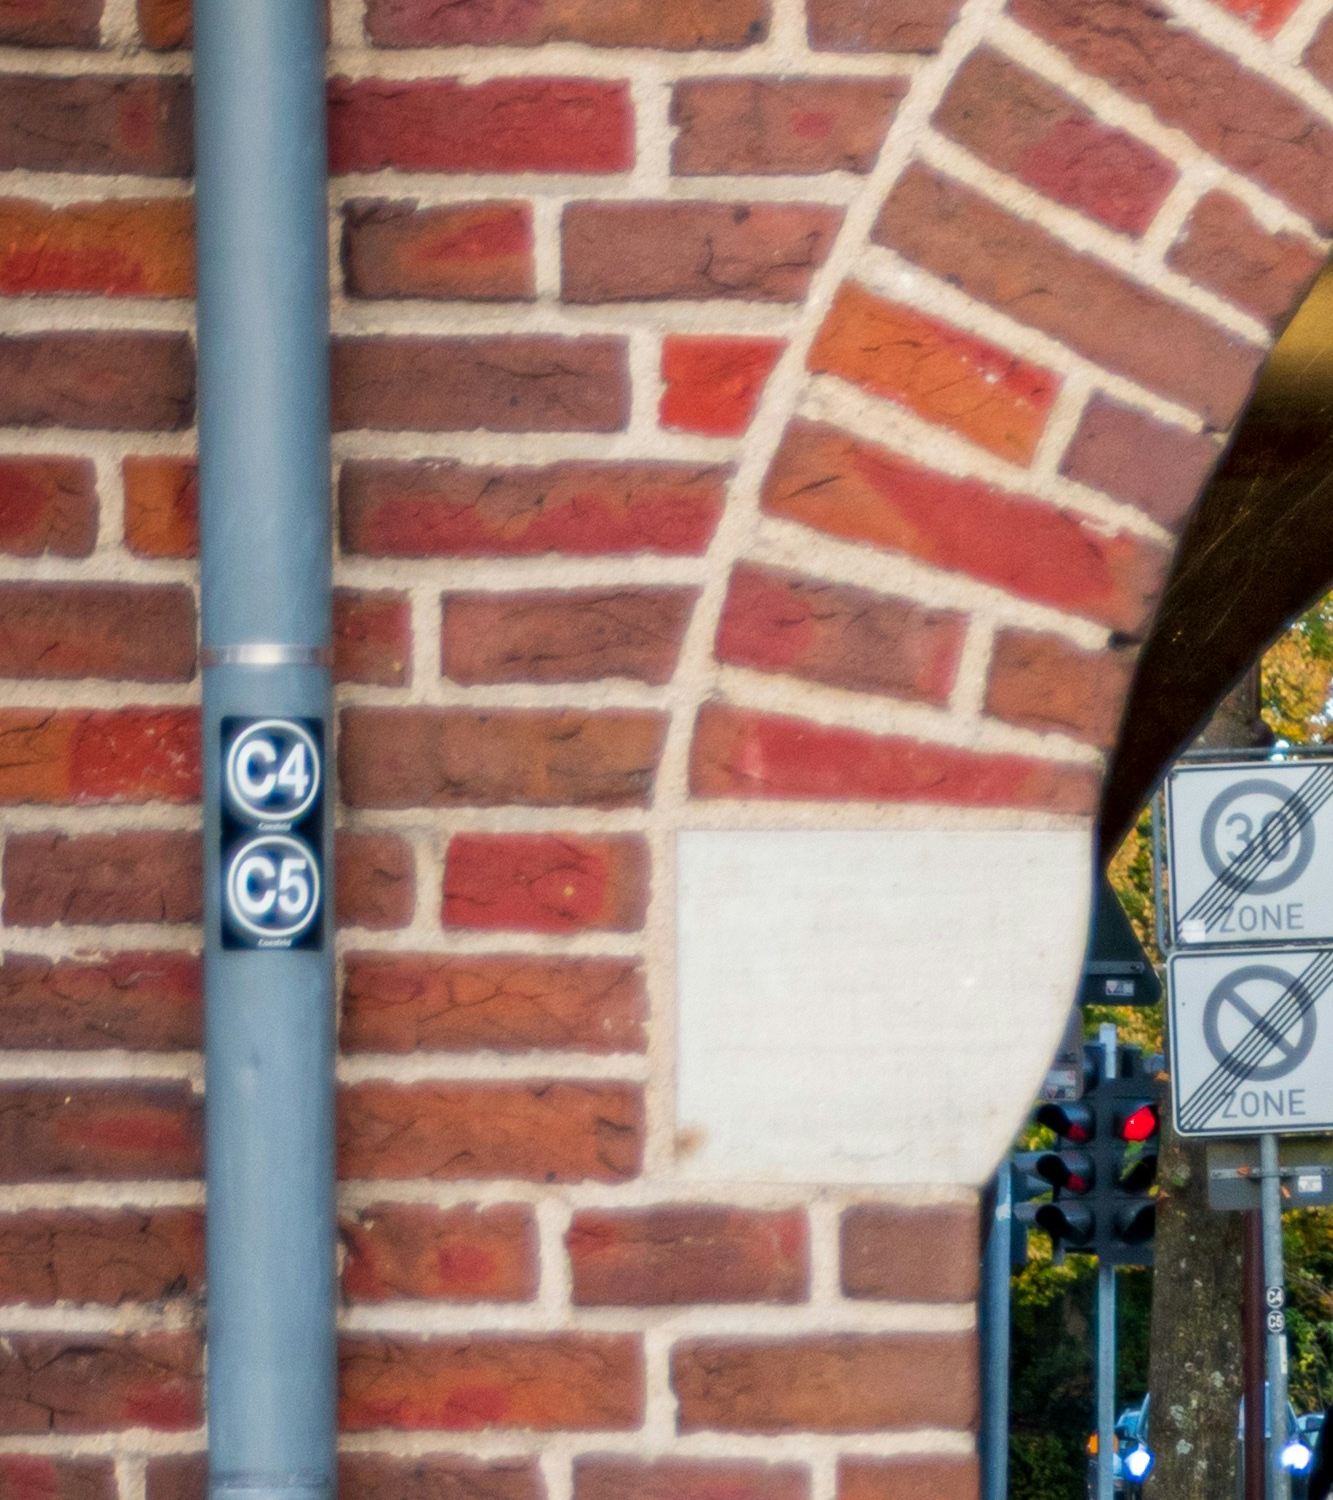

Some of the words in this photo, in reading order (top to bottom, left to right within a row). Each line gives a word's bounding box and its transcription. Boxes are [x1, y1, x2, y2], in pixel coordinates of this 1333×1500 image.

[236, 739, 310, 800] C4
[1224, 810, 1291, 863] 30
[236, 855, 310, 916] C5
[1219, 903, 1305, 933] ZONE
[1221, 1088, 1306, 1119] ZONE
[1267, 1290, 1282, 1303] C4
[1268, 1314, 1283, 1328] C5
